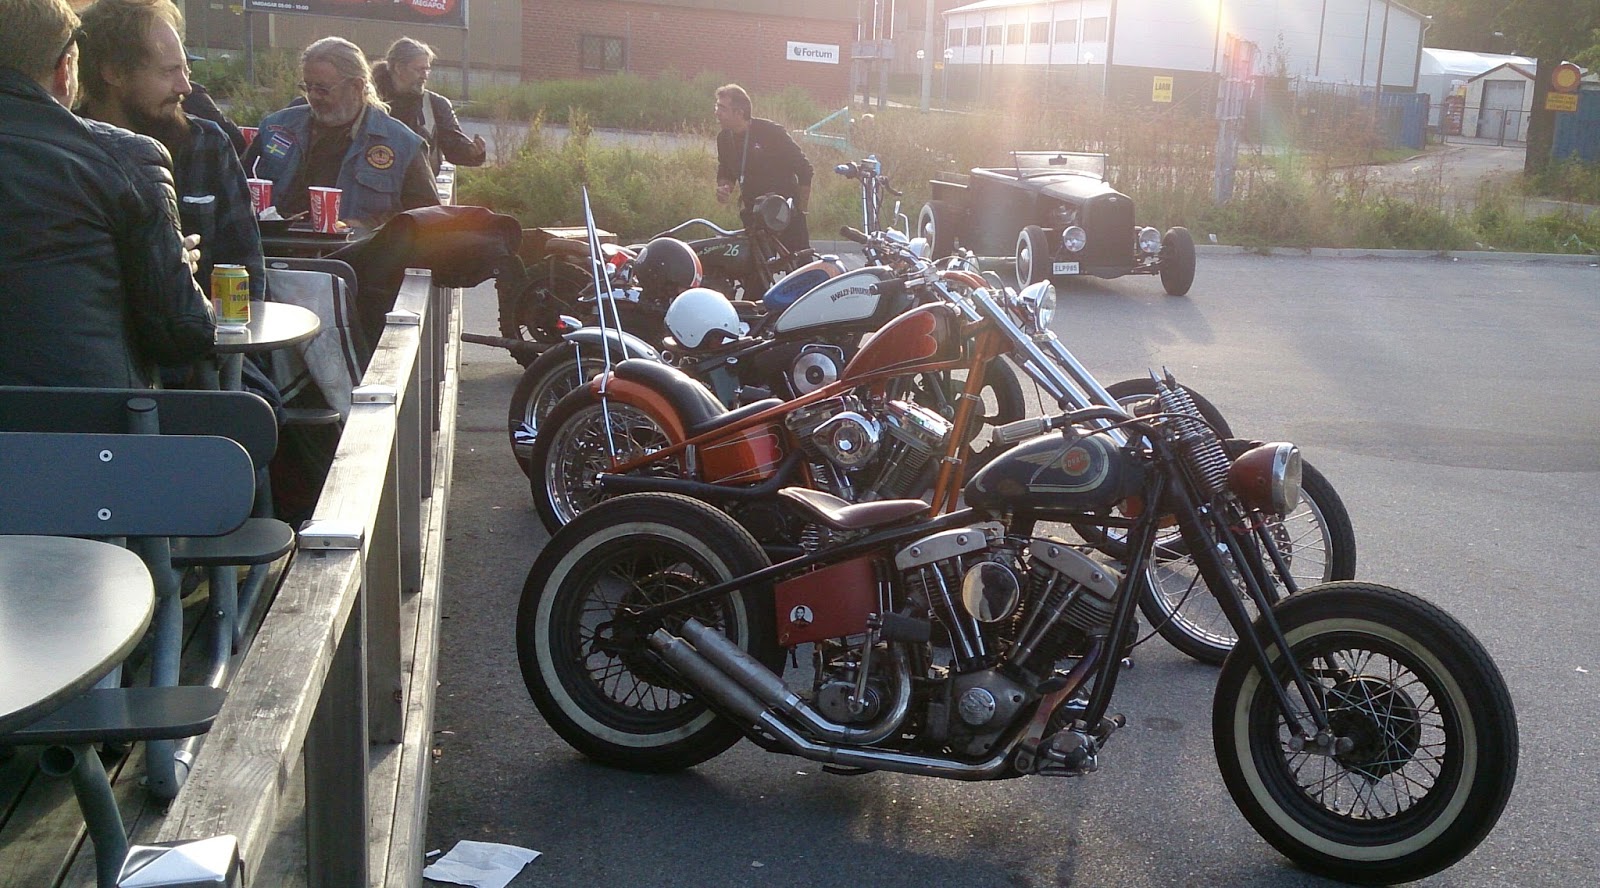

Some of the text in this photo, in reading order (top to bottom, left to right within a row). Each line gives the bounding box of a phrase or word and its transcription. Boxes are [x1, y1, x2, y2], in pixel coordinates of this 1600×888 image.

[412, 0, 446, 10] MEGAPOL
[802, 47, 833, 59] Fortum
[723, 243, 740, 257] 26
